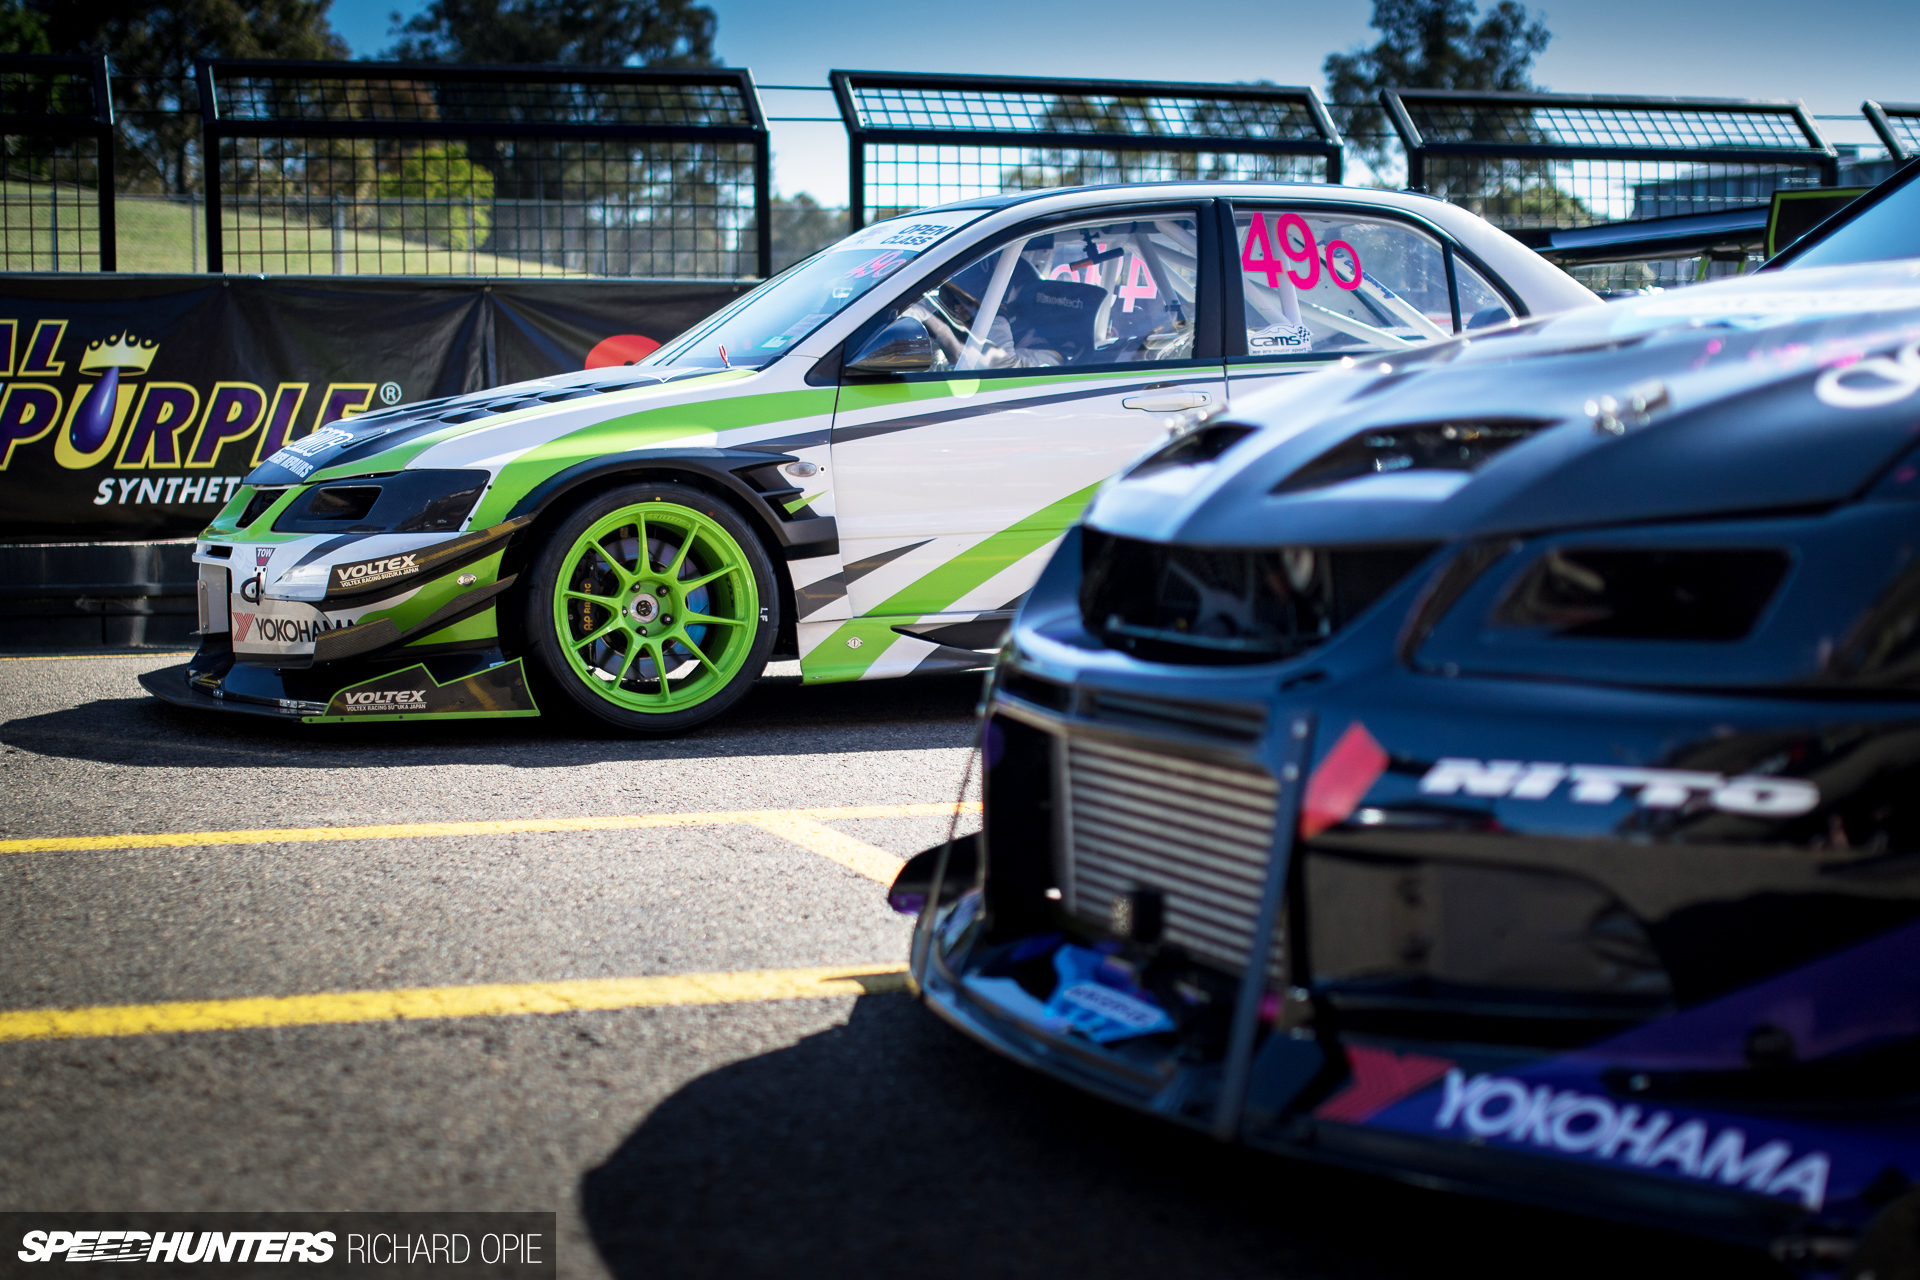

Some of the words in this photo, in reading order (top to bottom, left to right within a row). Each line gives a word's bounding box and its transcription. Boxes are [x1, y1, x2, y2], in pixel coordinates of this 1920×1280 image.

[899, 224, 954, 235] OPEN
[880, 236, 933, 245] CLASS
[1250, 336, 1301, 347] cams
[93, 476, 246, 504] SYNTHET
[257, 548, 273, 557] TOW
[337, 554, 416, 580] VOLTEX
[341, 578, 362, 588] VOLTEX
[362, 574, 381, 583] RACING
[381, 570, 402, 580] SUZUKA
[403, 566, 420, 575] JAPAN
[760, 607, 768, 622] LF
[345, 690, 426, 705] VOLTEX
[1419, 757, 1820, 816] NITTO
[1435, 1068, 1831, 1212] YOKOHAMA
